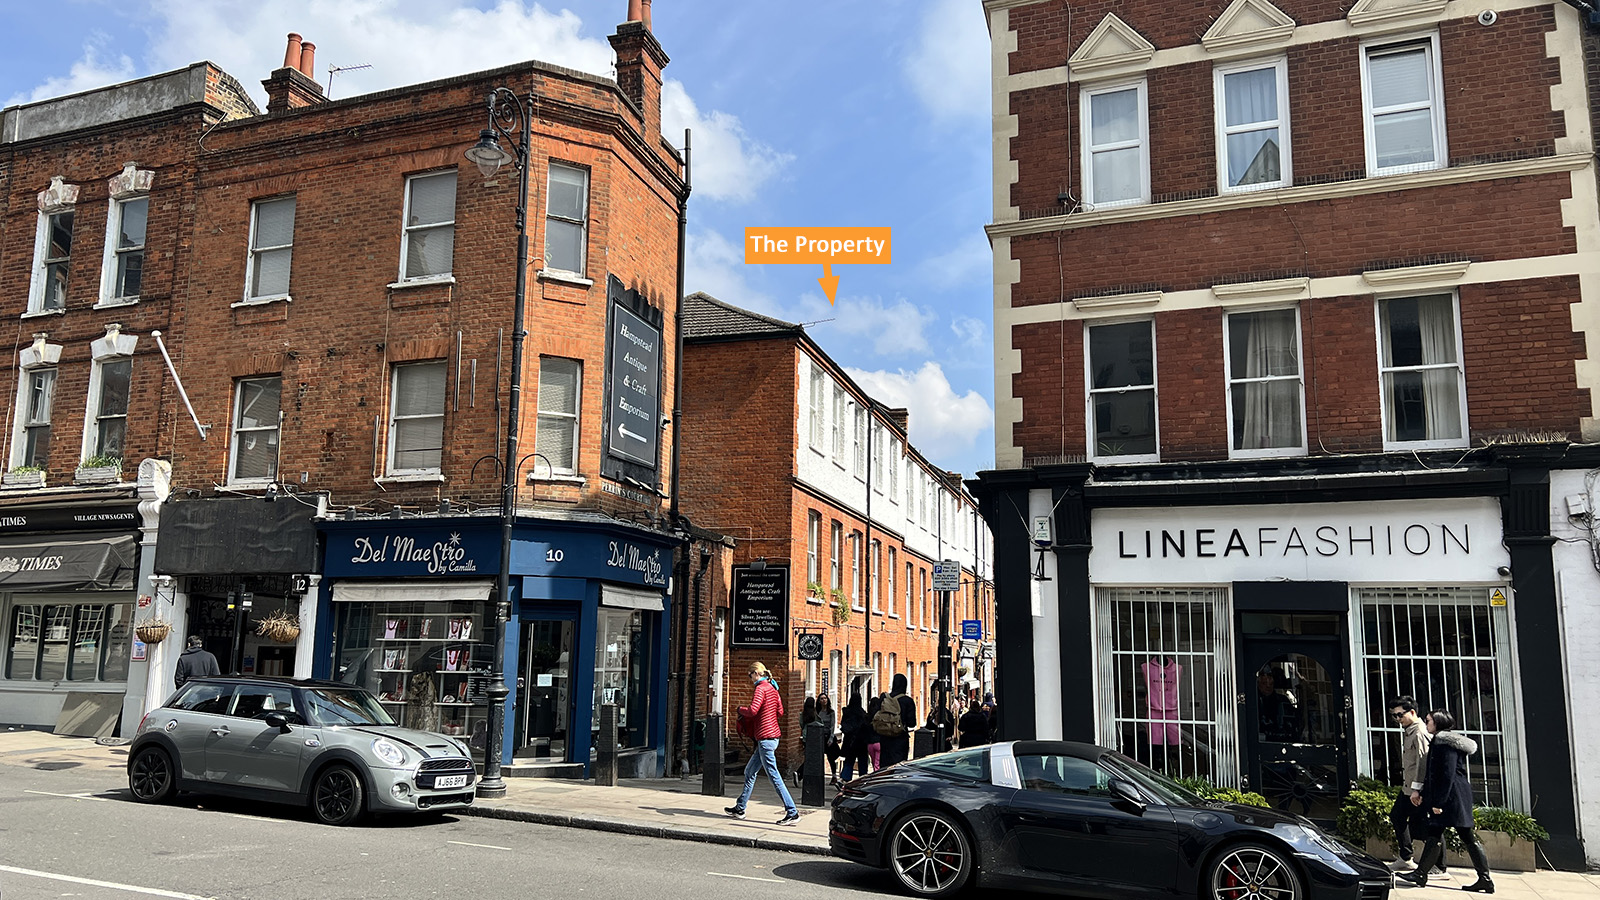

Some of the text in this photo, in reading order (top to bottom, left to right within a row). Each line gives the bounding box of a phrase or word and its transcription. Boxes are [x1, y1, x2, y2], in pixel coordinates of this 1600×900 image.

[620, 323, 653, 353] Hampstead
[623, 351, 648, 373] Antique
[623, 374, 647, 396] & Craft
[618, 396, 650, 421] Emporium
[1, 516, 26, 526] TIMES
[351, 535, 389, 563] Del
[546, 549, 564, 562] 10
[607, 541, 628, 568] Del
[20, 555, 63, 571] TIMES
[438, 559, 476, 574] by Camilla
[296, 579, 306, 590] 12
